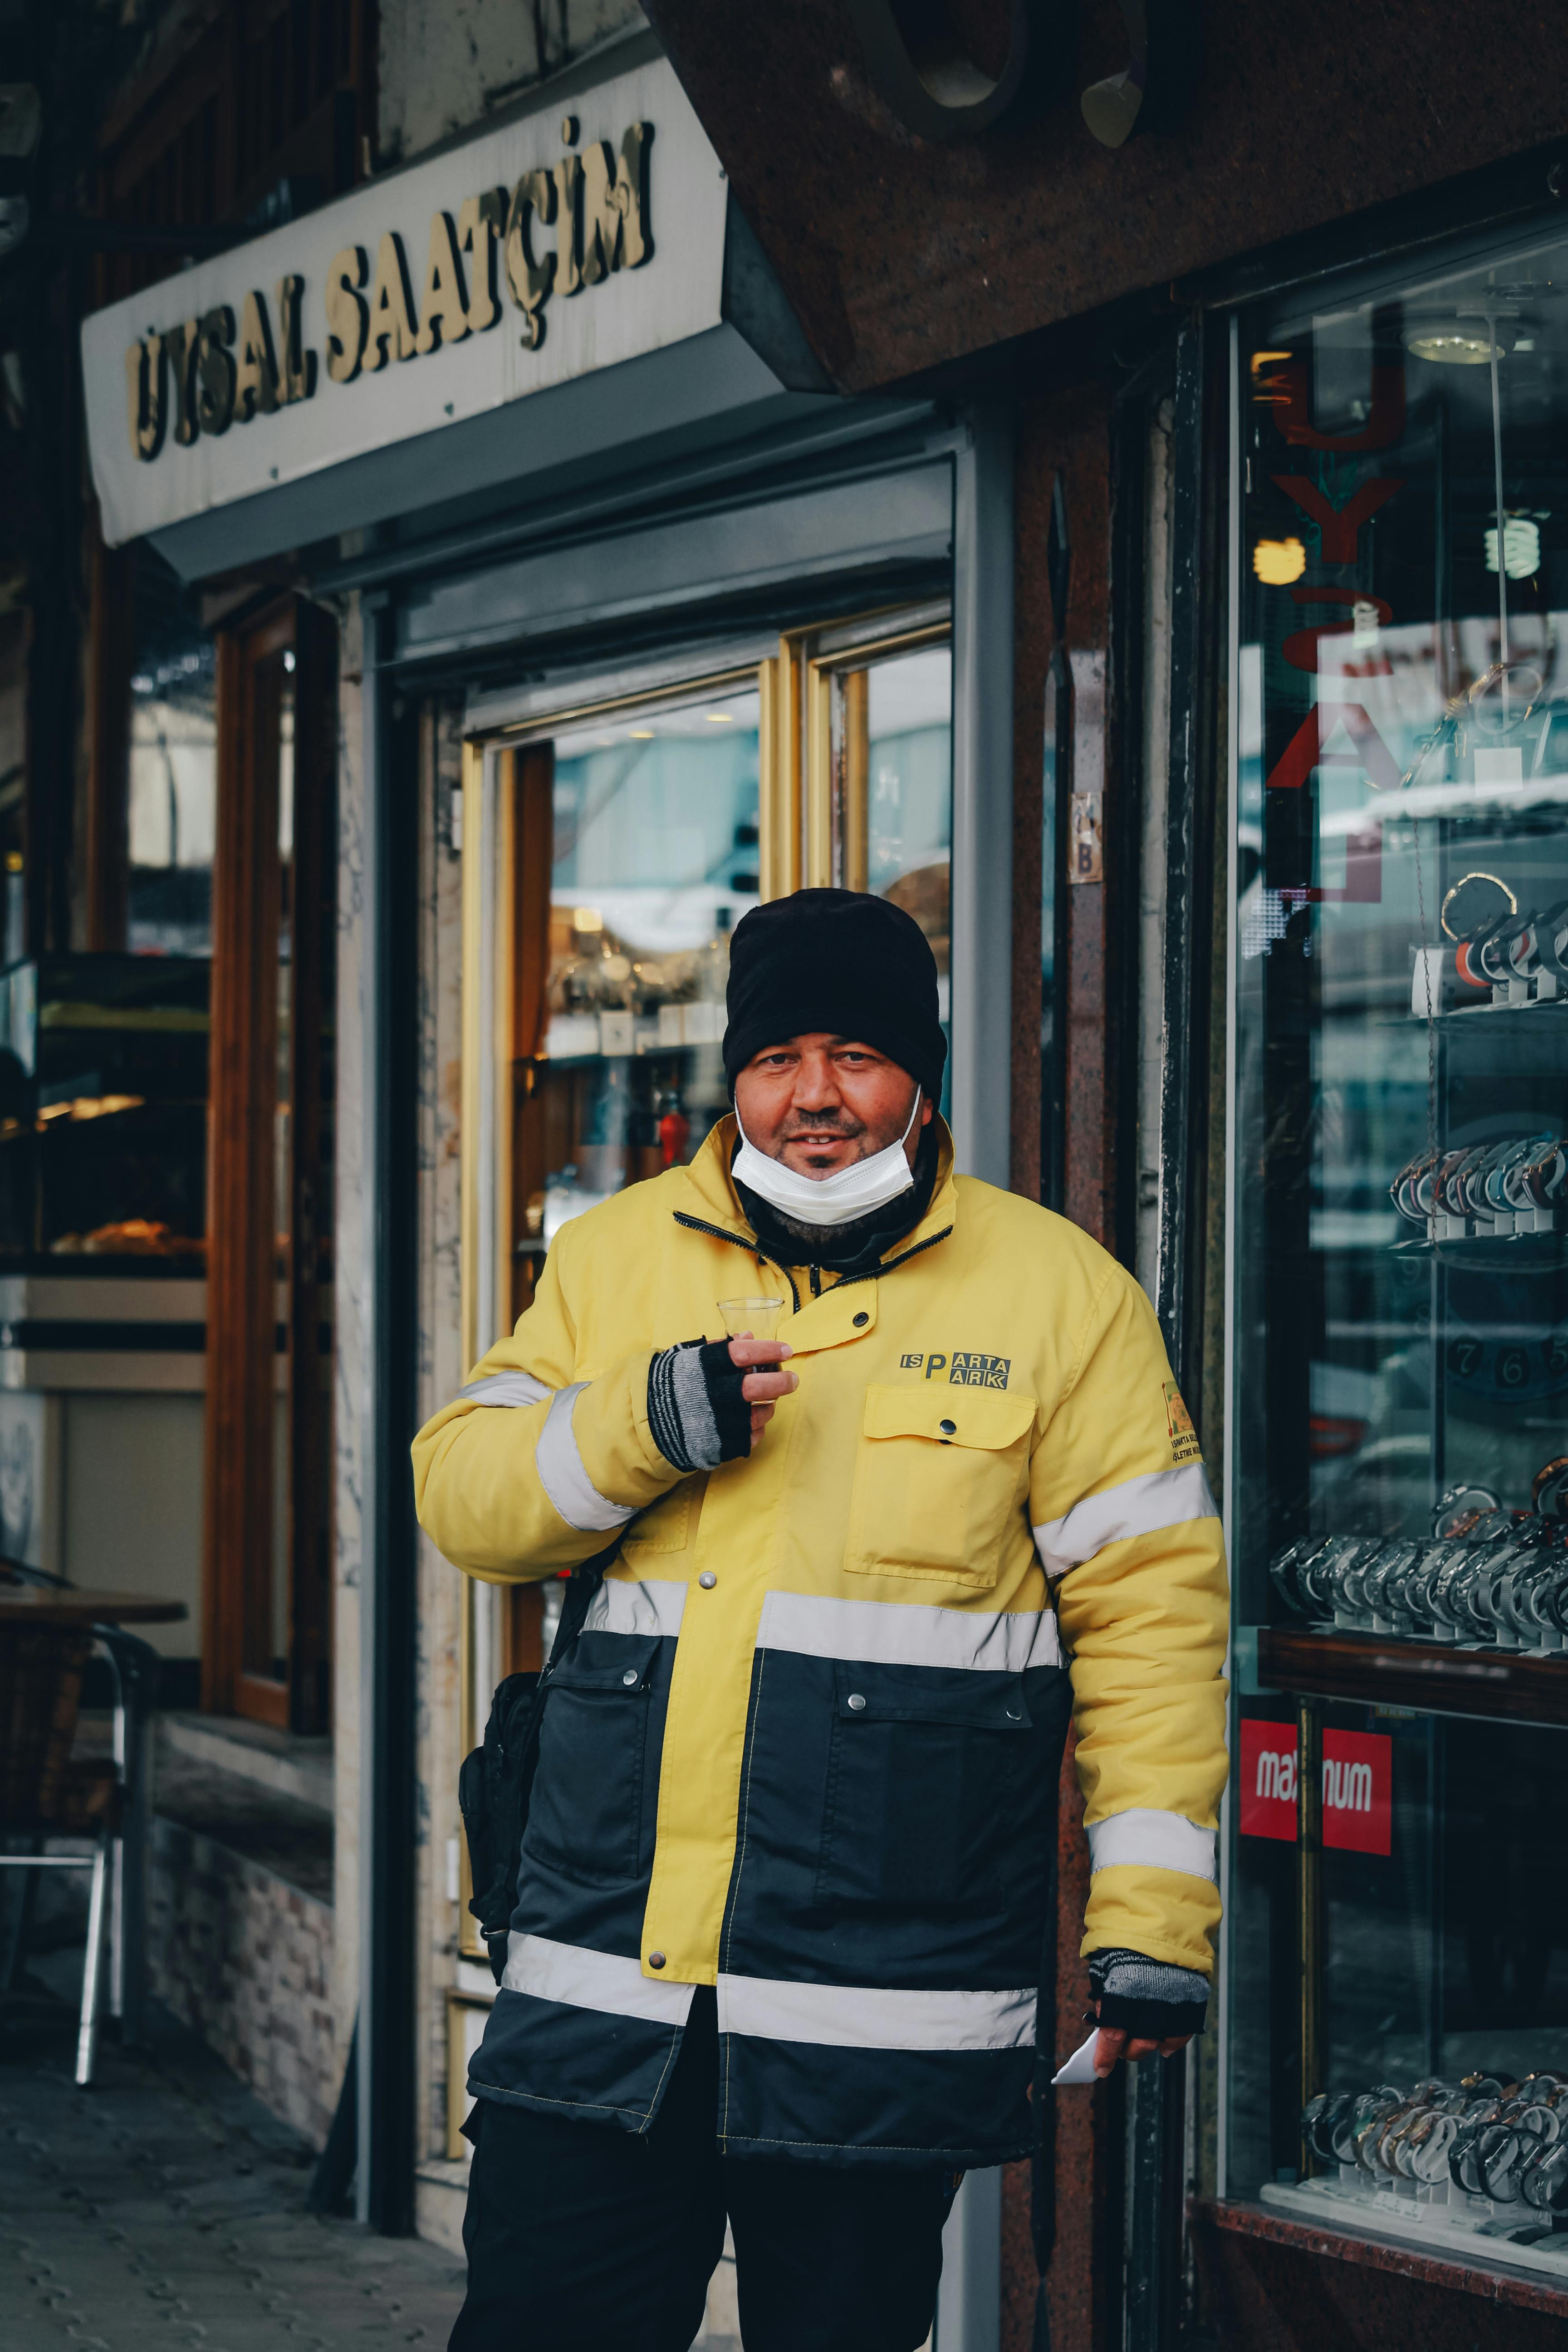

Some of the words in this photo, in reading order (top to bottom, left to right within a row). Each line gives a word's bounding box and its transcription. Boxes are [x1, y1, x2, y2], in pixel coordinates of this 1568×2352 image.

[125, 275, 317, 461] UYSAL
[324, 115, 655, 383] SAATÇİM
[1456, 1343, 1477, 1374] 7
[1503, 1353, 1522, 1384] 6
[1171, 1436, 1189, 1448] ISPARTA
